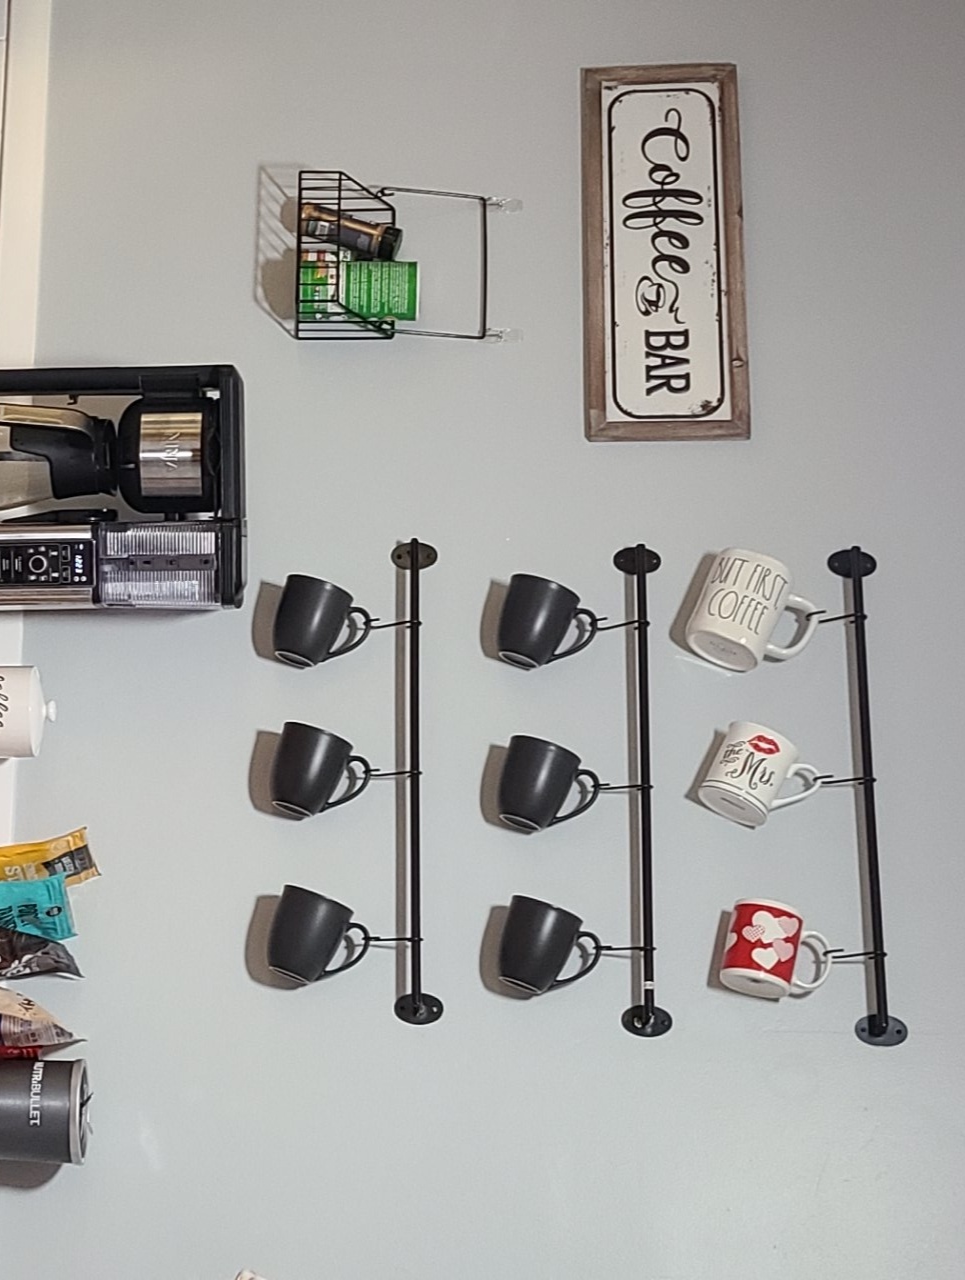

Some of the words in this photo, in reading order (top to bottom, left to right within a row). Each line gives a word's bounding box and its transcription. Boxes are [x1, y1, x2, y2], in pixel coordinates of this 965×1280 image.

[622, 107, 704, 280] Coffee
[644, 328, 691, 397] BAR
[708, 588, 769, 635] COFFEE
